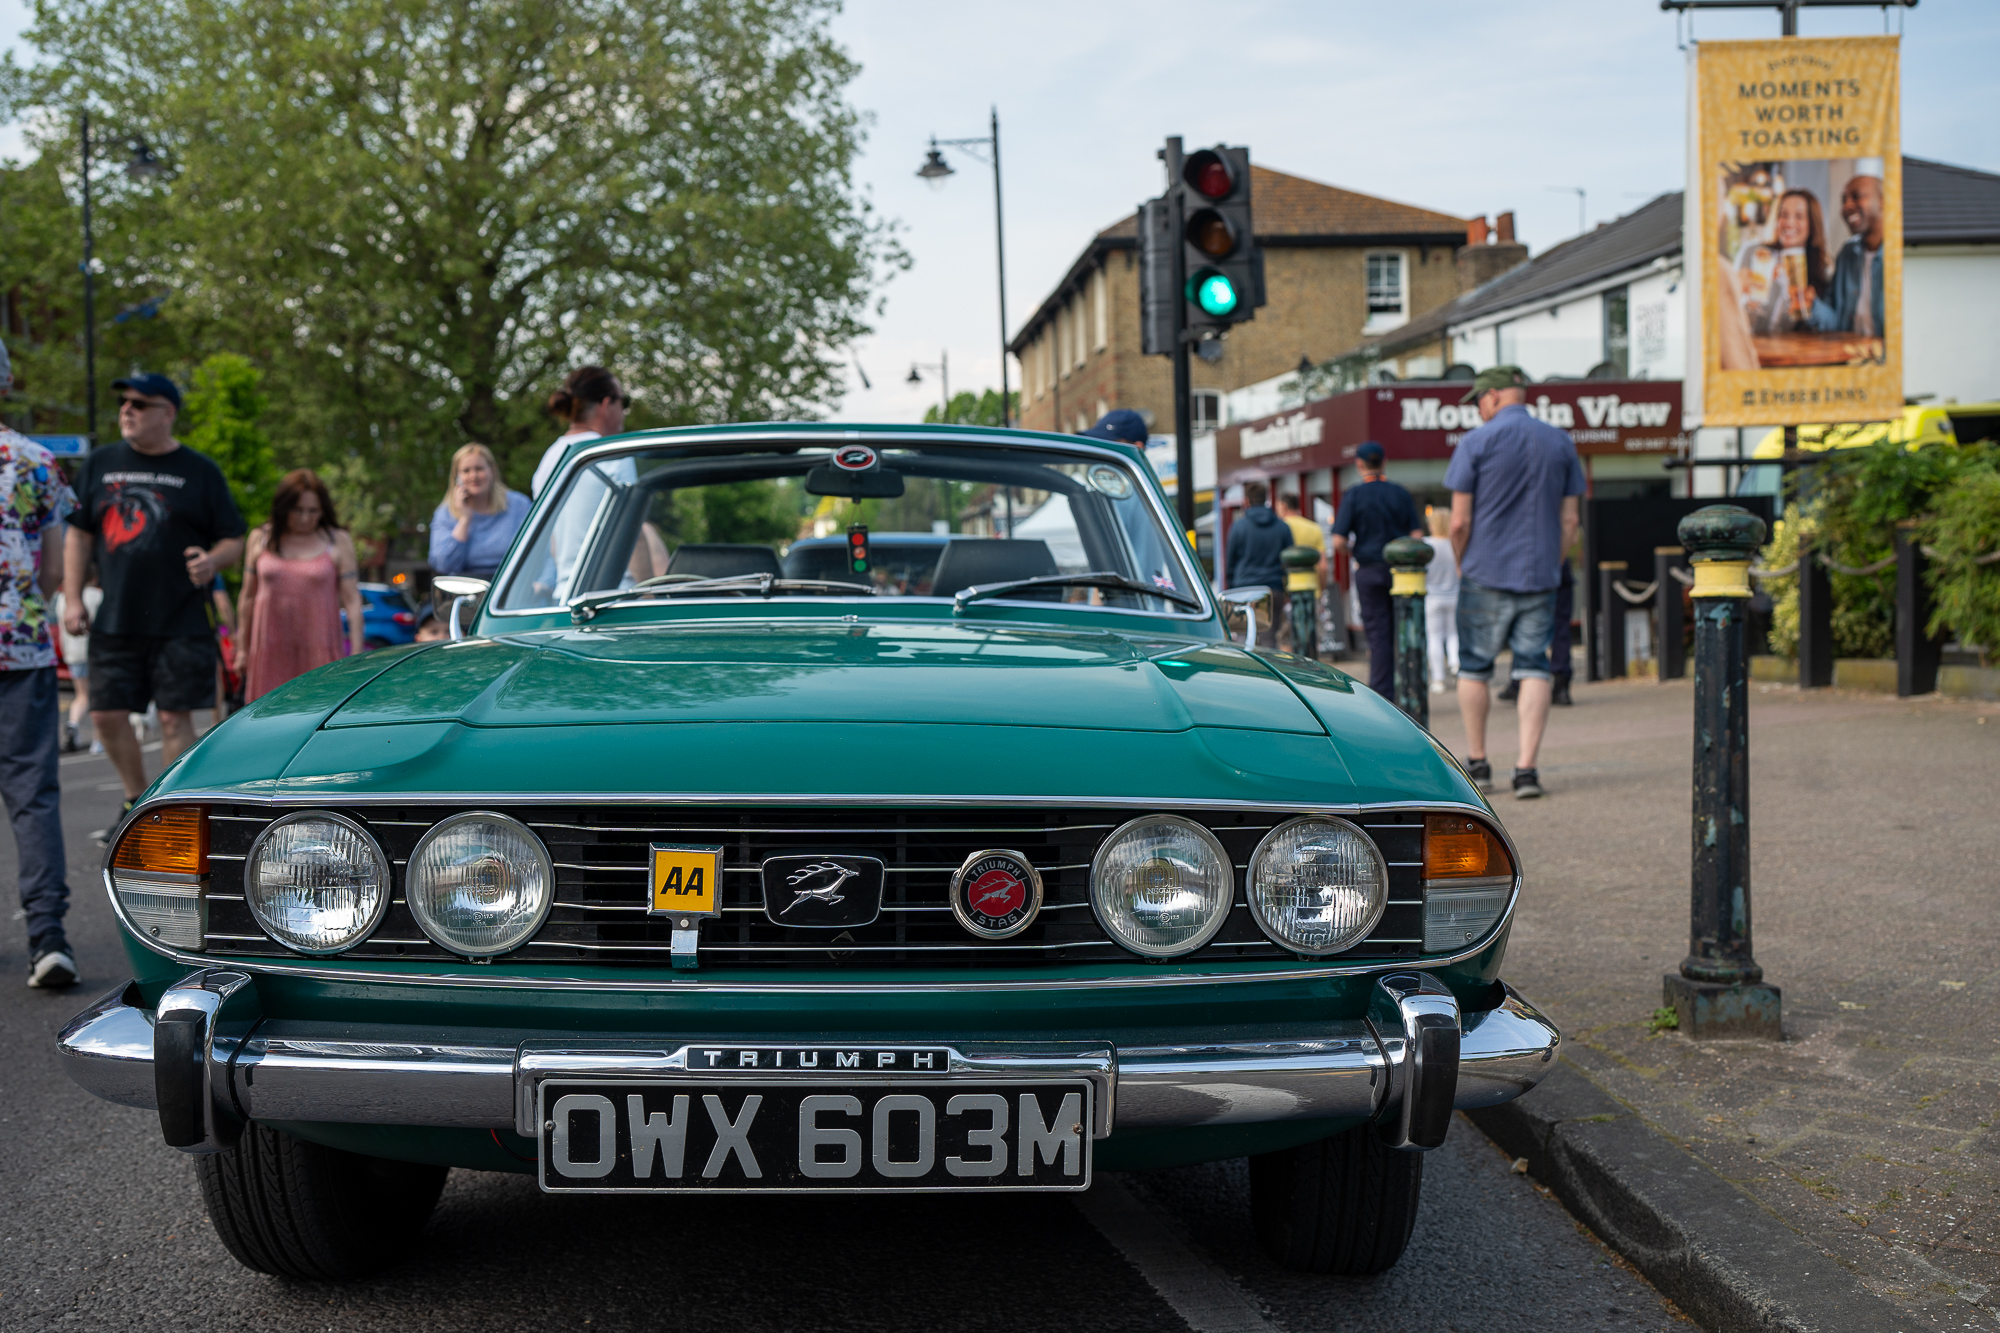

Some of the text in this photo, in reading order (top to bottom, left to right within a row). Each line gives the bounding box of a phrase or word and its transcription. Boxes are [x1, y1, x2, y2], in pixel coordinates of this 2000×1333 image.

[1739, 79, 1860, 99] MOMENTS
[1754, 104, 1843, 122] WORTH
[1739, 127, 1860, 148] TOASTING
[1401, 394, 1671, 430] Mouin View
[971, 860, 1021, 877] TRIUMPH
[660, 866, 704, 896] AA
[976, 914, 1018, 928] STAG
[704, 1050, 934, 1069] TRIUMPH
[552, 1093, 1082, 1178] OWX 603M
